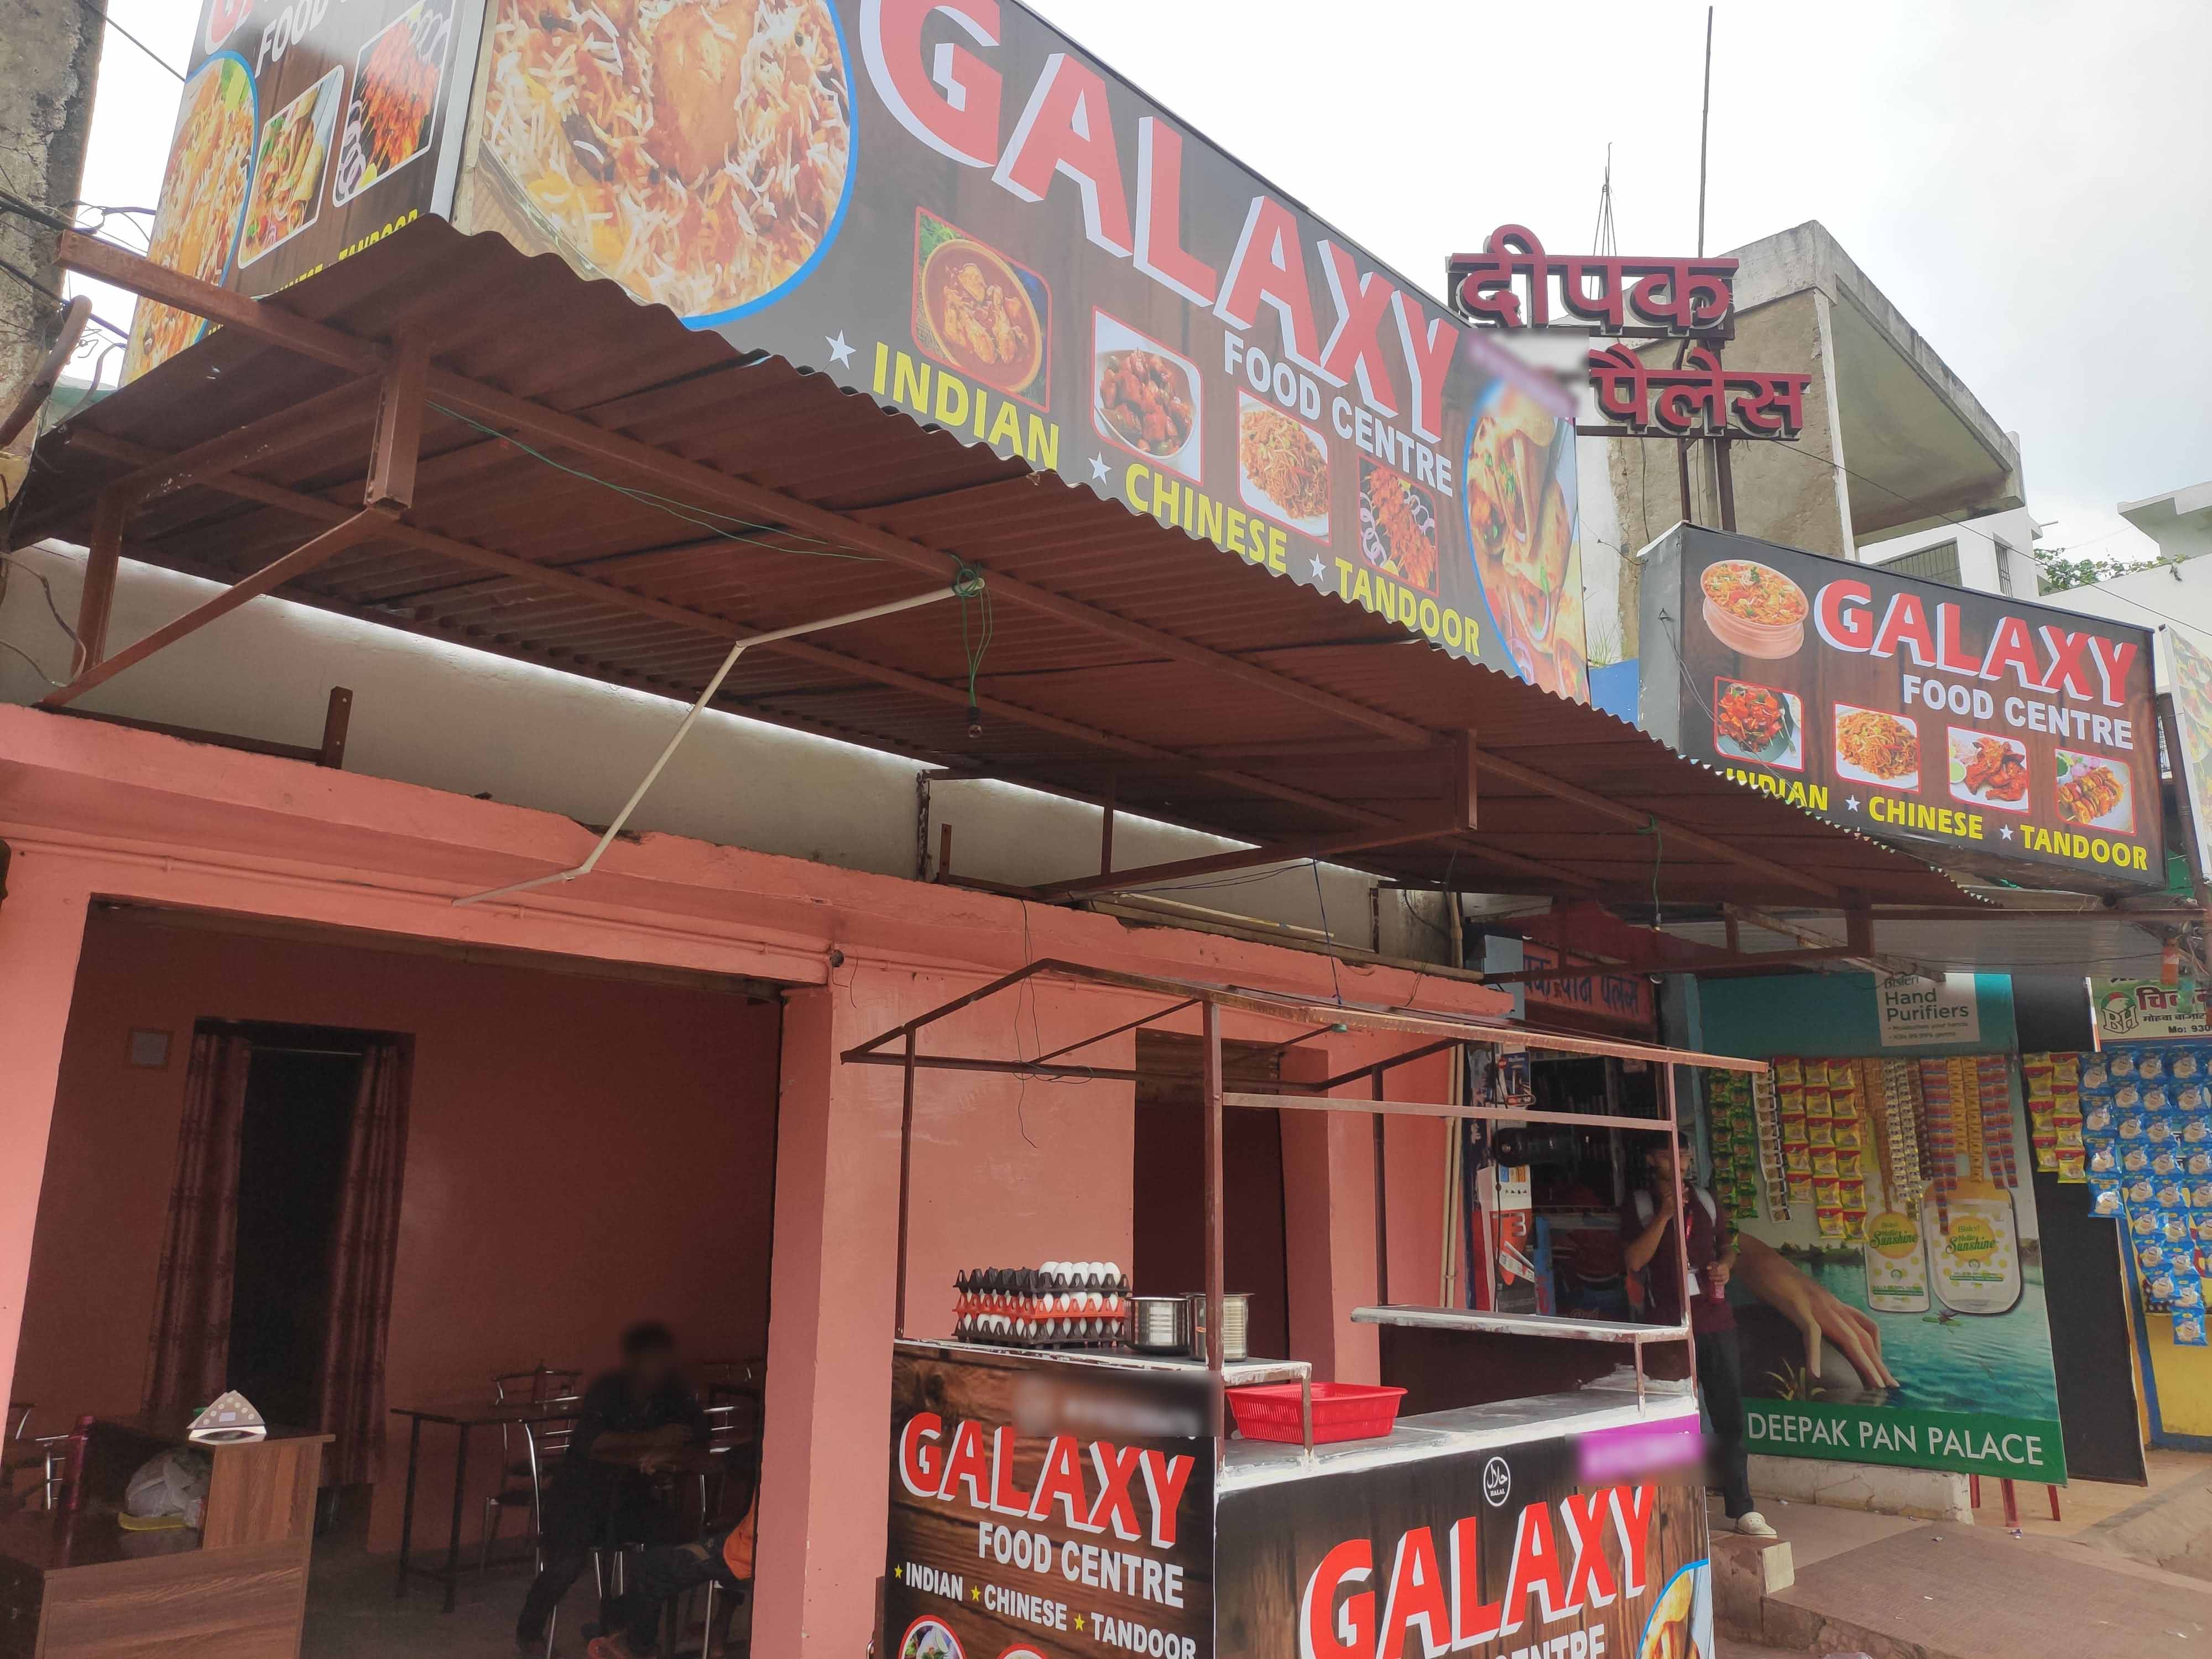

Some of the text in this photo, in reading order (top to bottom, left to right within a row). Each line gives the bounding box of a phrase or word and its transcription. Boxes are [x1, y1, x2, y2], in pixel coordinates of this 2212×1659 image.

[859, 0, 1459, 444] GALAXY
[1449, 224, 1739, 331] दीपक
[1224, 330, 1453, 498] FOOD CENTRE
[1589, 343, 1812, 434] पैलेस
[873, 341, 1480, 657] INDIAN CHINESE TANDOOR
[1814, 579, 2138, 707] GALAXY
[1903, 674, 2134, 750] FOOD CENTRE
[1868, 796, 1983, 839] CHINESE
[2020, 824, 2148, 871] TANDOOR
[1885, 988, 1937, 1005] Hand
[1886, 1005, 1969, 1022] Purifiers
[2101, 1005, 2140, 1034] BH
[1870, 1230, 1918, 1249] Sunshine
[1945, 1236, 1997, 1254] Sunshine
[1486, 1464, 1508, 1489] حلال
[1747, 1412, 2043, 1465] DEEPAK PAN PALACE
[899, 1412, 1195, 1549] GALAXY
[1490, 1488, 1505, 1496] HALAL
[978, 1521, 1184, 1609] FOOD CENTRE
[1300, 1482, 1655, 1659] GALAXY
[906, 1562, 1196, 1659] INDIAN CHINESE TANDOOR
[1495, 1623, 1605, 1659] NTRE
